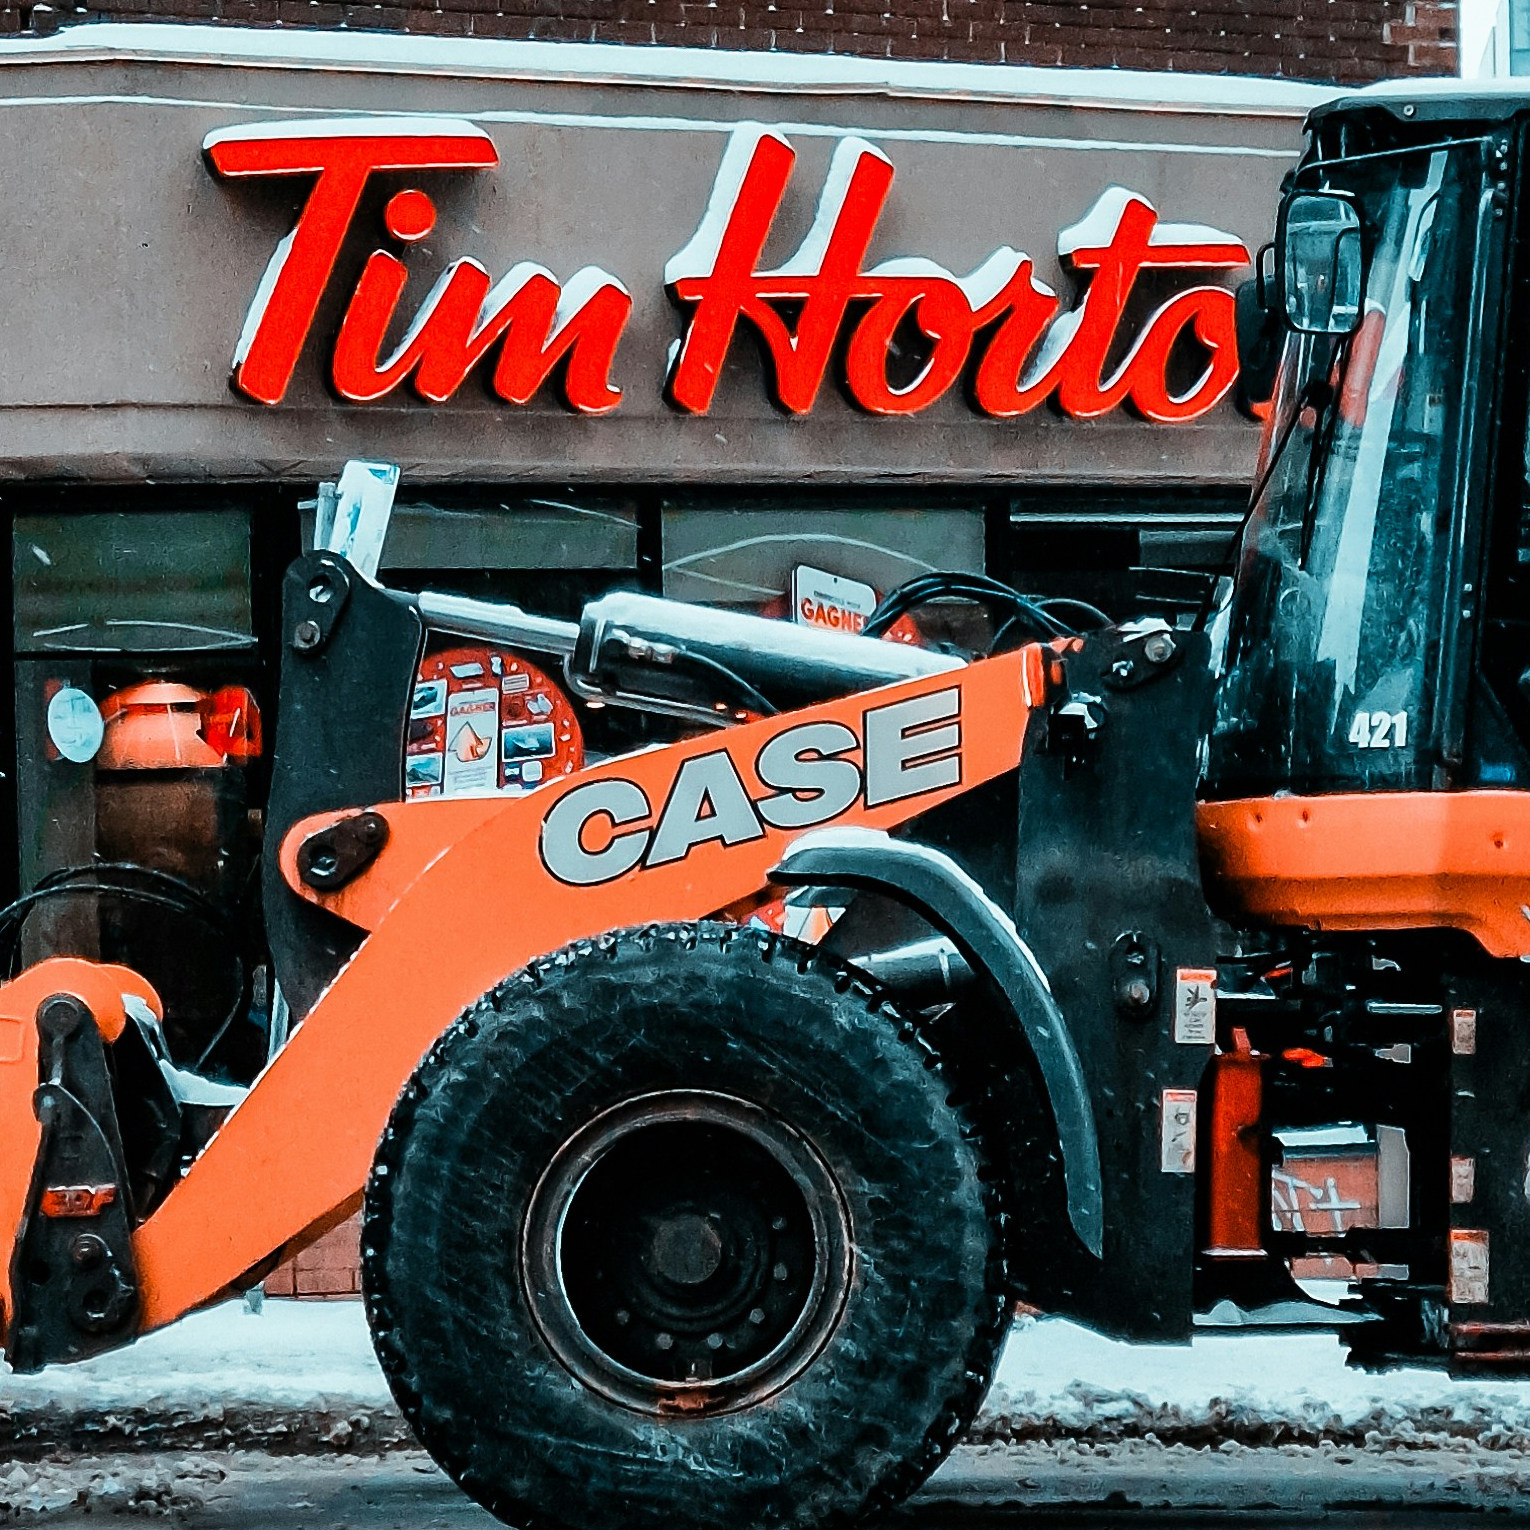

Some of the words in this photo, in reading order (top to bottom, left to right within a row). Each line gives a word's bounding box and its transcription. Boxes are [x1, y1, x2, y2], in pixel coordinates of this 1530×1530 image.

[203, 120, 633, 415] Tim
[665, 123, 1260, 422] Horto
[800, 597, 868, 634] GAGNE
[539, 685, 963, 887] CASE
[1349, 710, 1408, 749] 421
